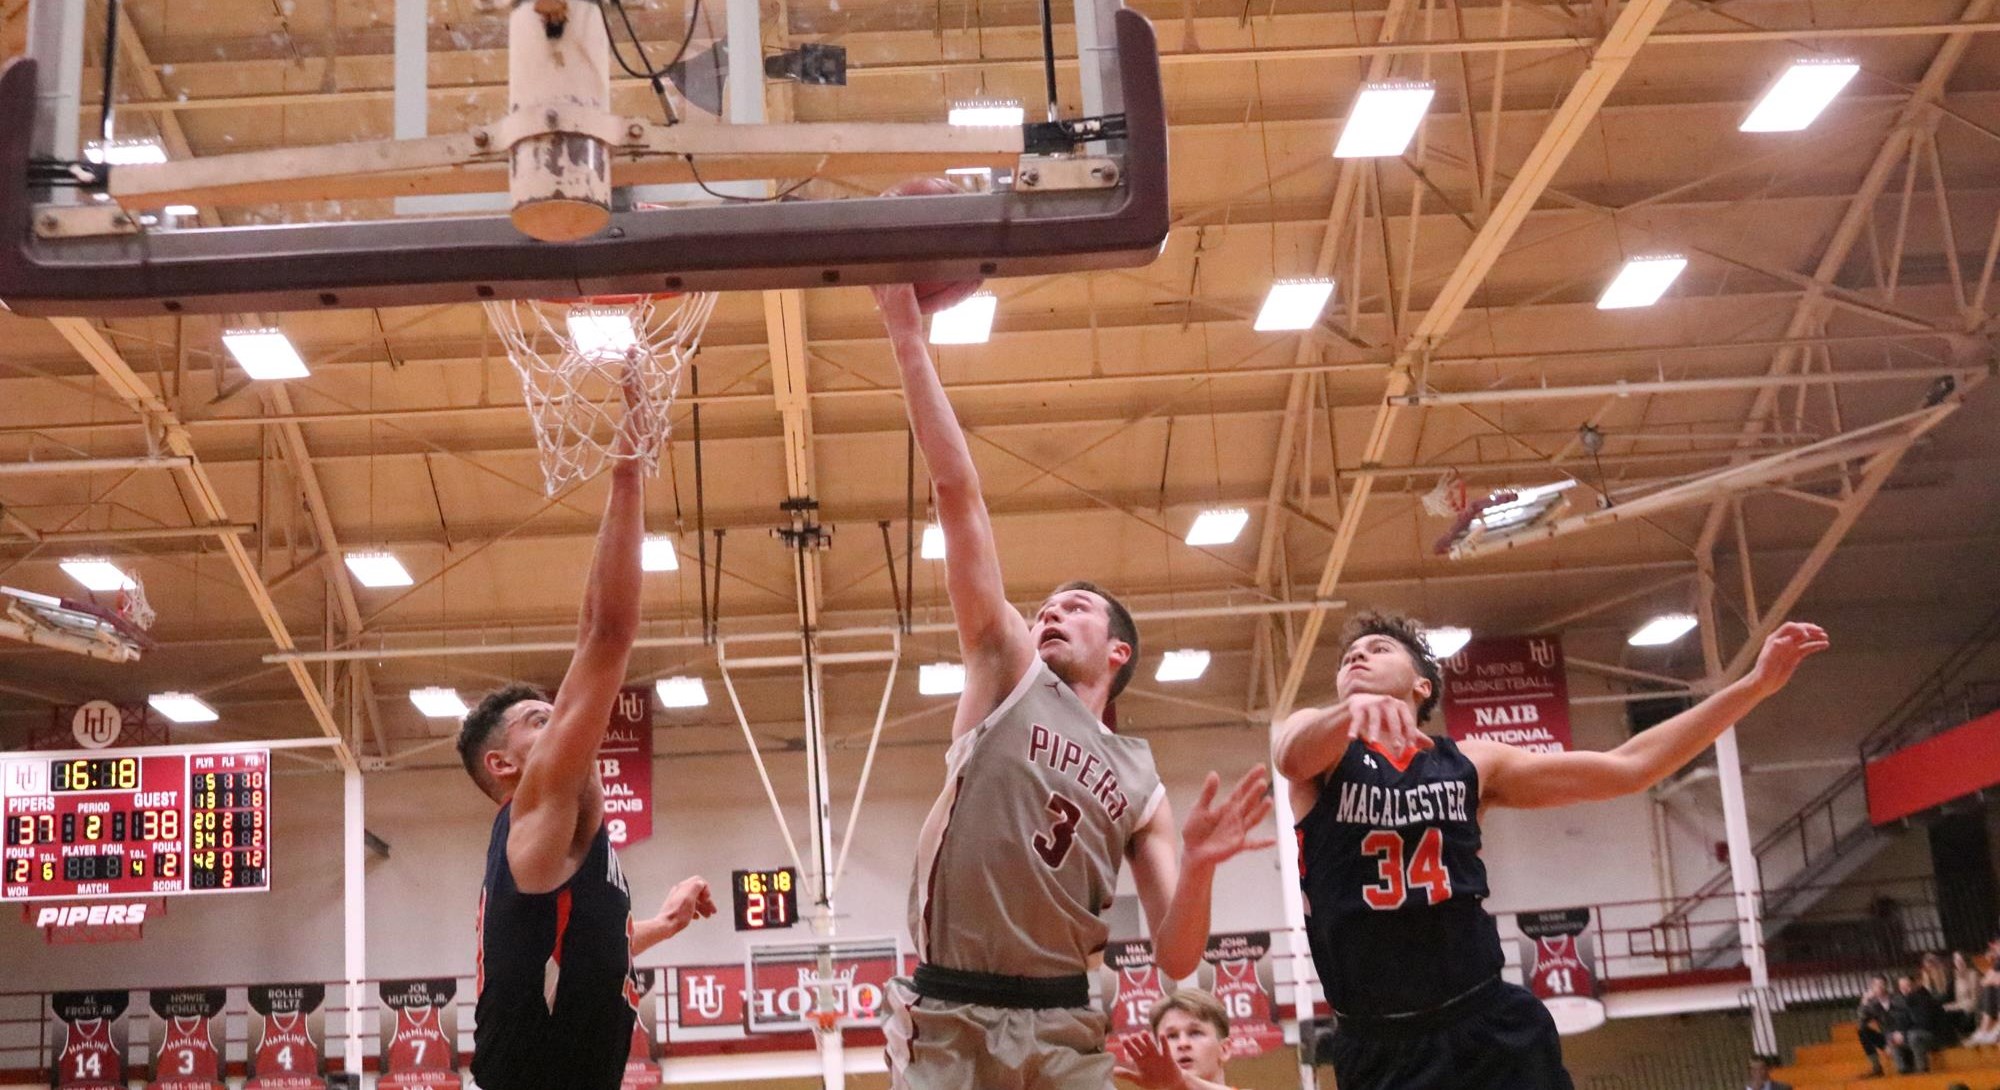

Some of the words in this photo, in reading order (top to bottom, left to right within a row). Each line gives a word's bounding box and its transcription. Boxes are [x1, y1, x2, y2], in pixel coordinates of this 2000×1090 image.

[1452, 676, 1554, 693] BASKETBALL
[1473, 704, 1539, 727] NAIB
[1465, 727, 1554, 744] NATIONAL
[196, 757, 214, 768] PLYR
[65, 758, 136, 790] 16:18
[206, 773, 216, 791] 5
[1028, 724, 1128, 823] PIPERS
[9, 797, 55, 813] PIPERS
[77, 802, 110, 813] PERIOD
[134, 791, 177, 808] GUEST
[1336, 780, 1468, 827] MACALESTER
[19, 815, 54, 845] 37
[86, 815, 101, 840] 2
[143, 810, 178, 840] 38
[1032, 790, 1082, 871] 3
[6, 847, 35, 858] FOULS
[62, 845, 96, 856] PLAYER
[102, 843, 124, 855] FOUL
[153, 842, 182, 853] FOULS
[15, 859, 29, 882] 2
[42, 862, 53, 881] 6
[133, 860, 143, 876] 4
[164, 853, 177, 877] 2
[1361, 828, 1452, 910] 34
[77, 883, 109, 895] MATCH
[153, 880, 182, 892] SCORE
[744, 871, 791, 893] 16:18
[7, 886, 28, 897] WON
[37, 904, 147, 927] PIPERS
[747, 894, 785, 926] 21
[1125, 943, 1146, 954] HAL
[1220, 936, 1247, 948] JOHN
[841, 964, 857, 982] of
[1546, 968, 1575, 994] 41
[408, 983, 427, 994] JOE
[1224, 993, 1252, 1018] 16
[166, 1037, 208, 1052] HAMLINE
[265, 1033, 307, 1048] HAMLINE
[397, 1028, 439, 1043] HAMLINE
[68, 1040, 110, 1054] HAMLINE
[410, 1040, 426, 1064] 7
[75, 1053, 101, 1078] 14
[178, 1050, 194, 1074] 3
[277, 1046, 293, 1070] 4
